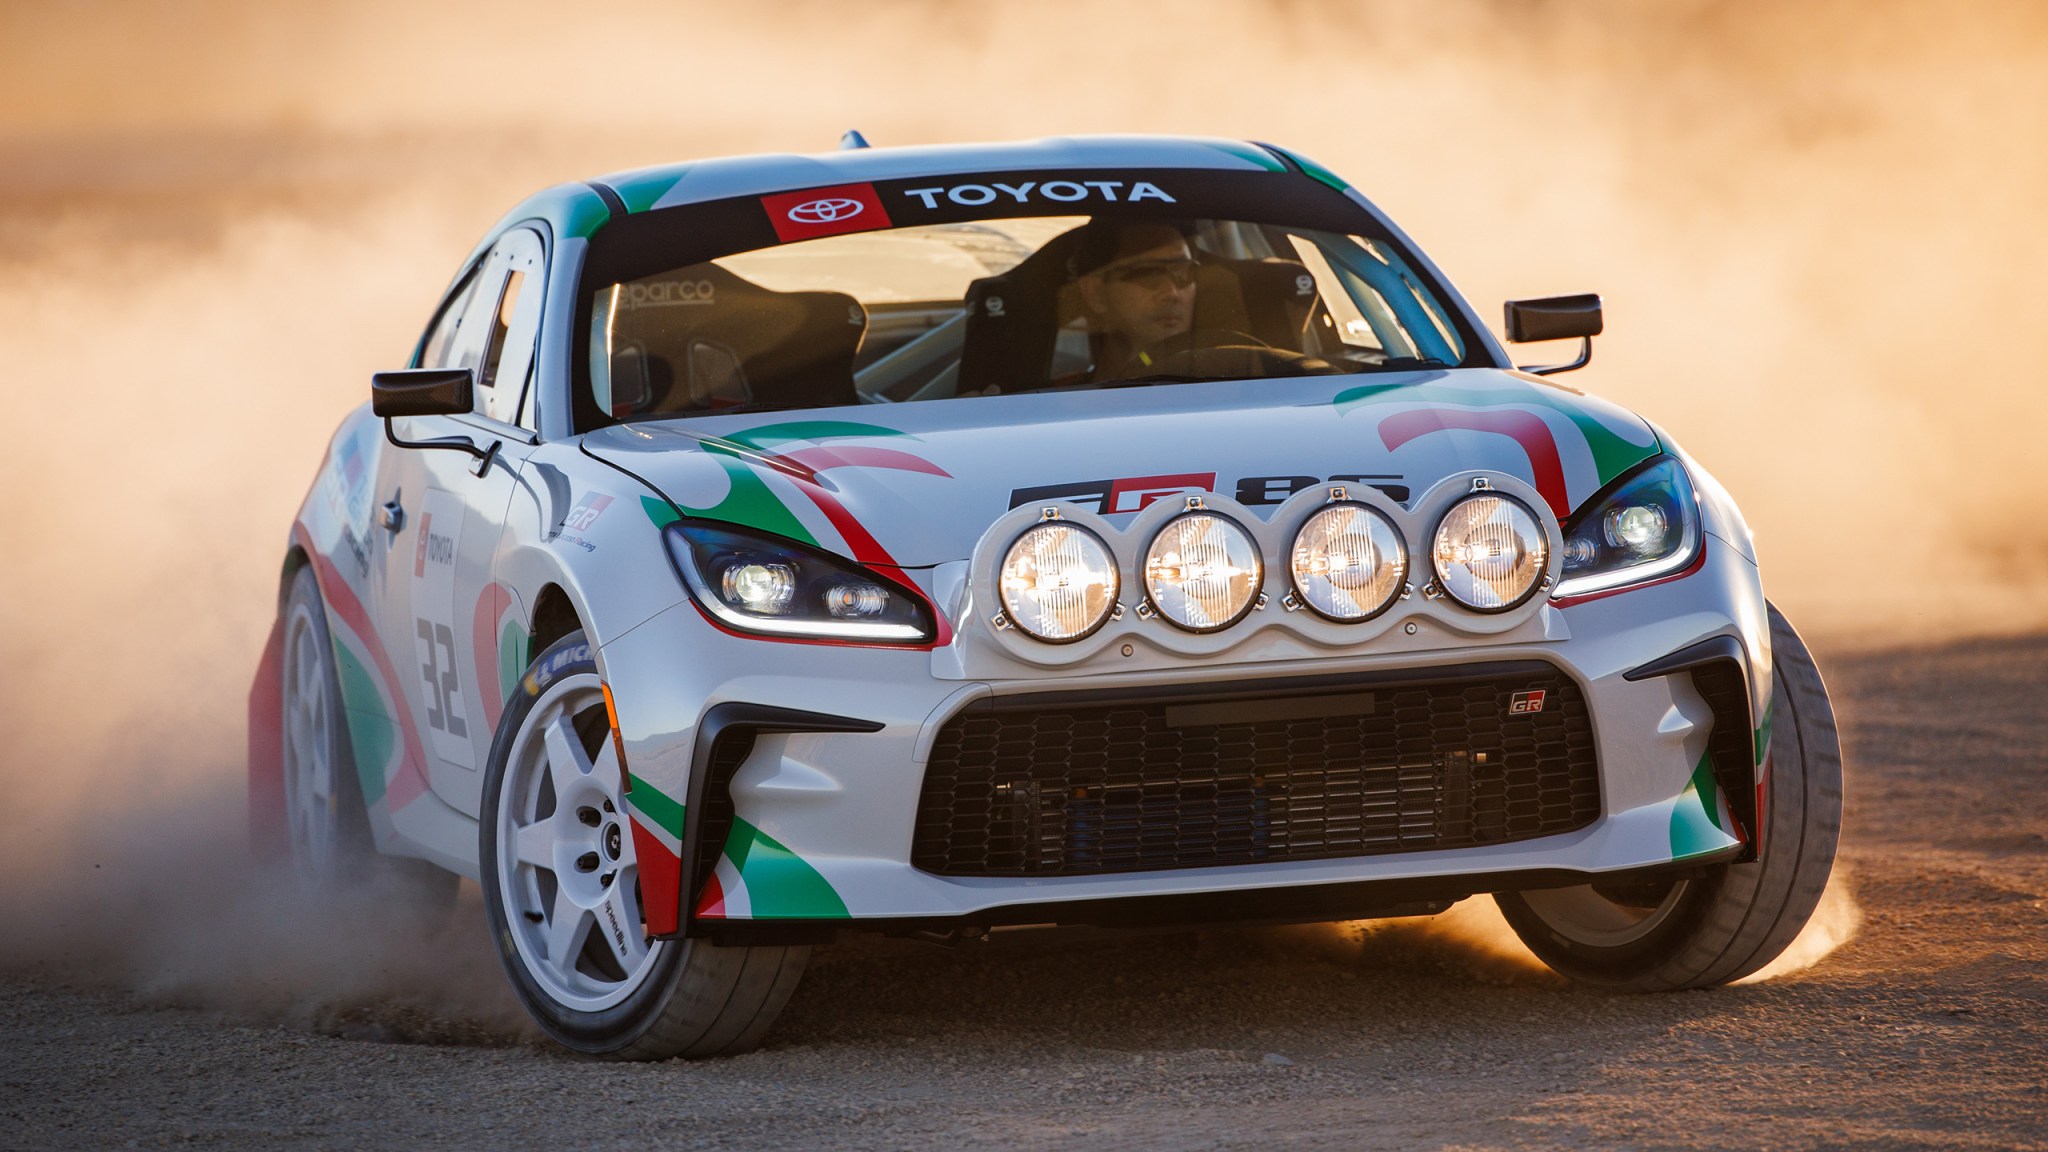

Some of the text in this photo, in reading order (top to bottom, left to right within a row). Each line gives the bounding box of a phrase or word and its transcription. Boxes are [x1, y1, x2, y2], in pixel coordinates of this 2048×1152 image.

[905, 181, 1176, 209] TOYOTA
[564, 505, 600, 530] GR
[428, 533, 453, 566] TOYOTA
[417, 617, 468, 738] 32
[604, 900, 628, 957] speedline
